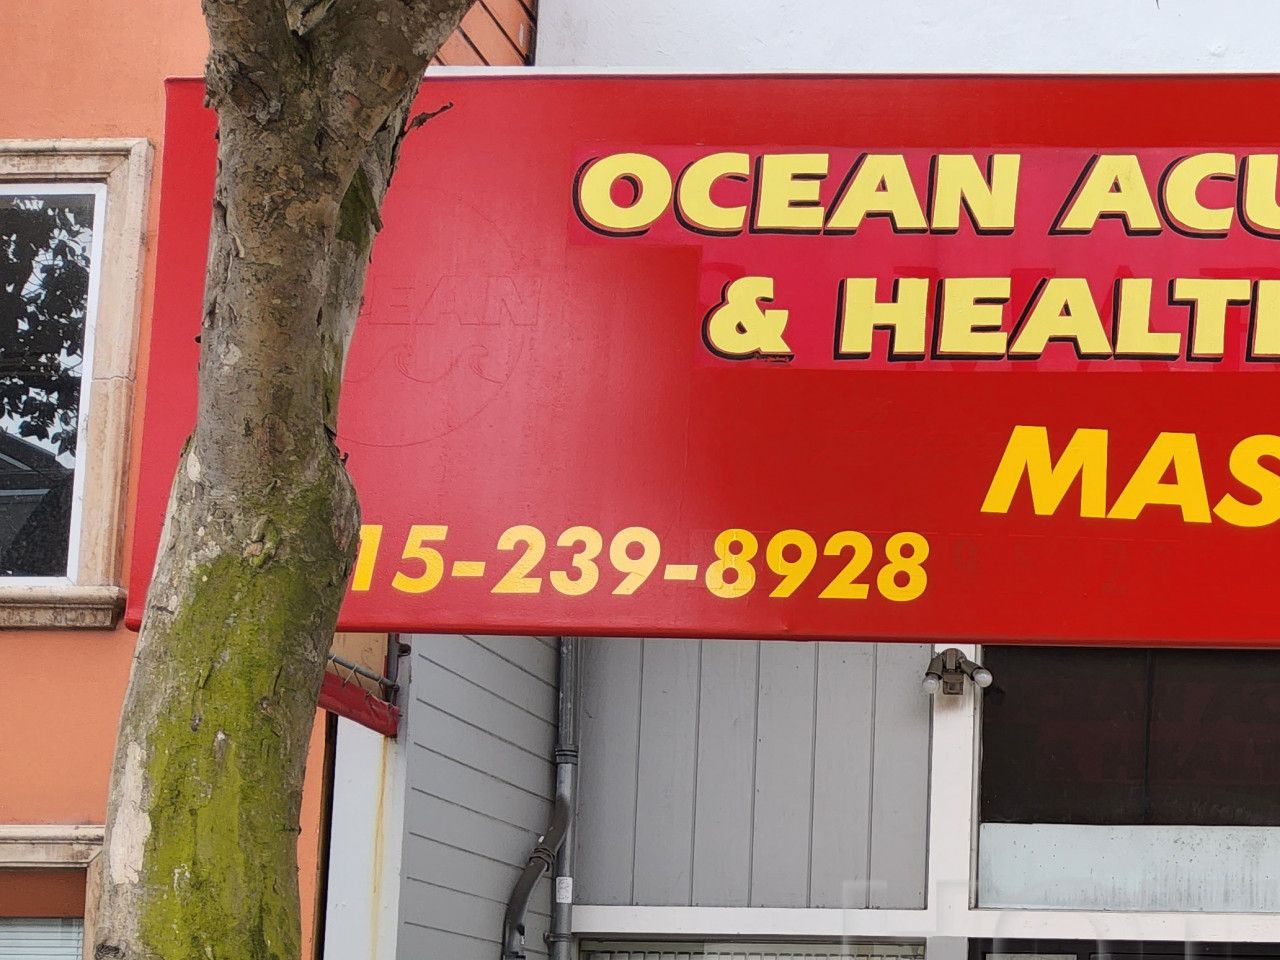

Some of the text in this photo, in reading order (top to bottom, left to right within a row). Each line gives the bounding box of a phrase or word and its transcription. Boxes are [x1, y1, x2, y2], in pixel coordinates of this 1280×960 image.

[574, 152, 1021, 237] OCEAN
[701, 275, 796, 364] &
[351, 524, 928, 603] 15-239-8928
